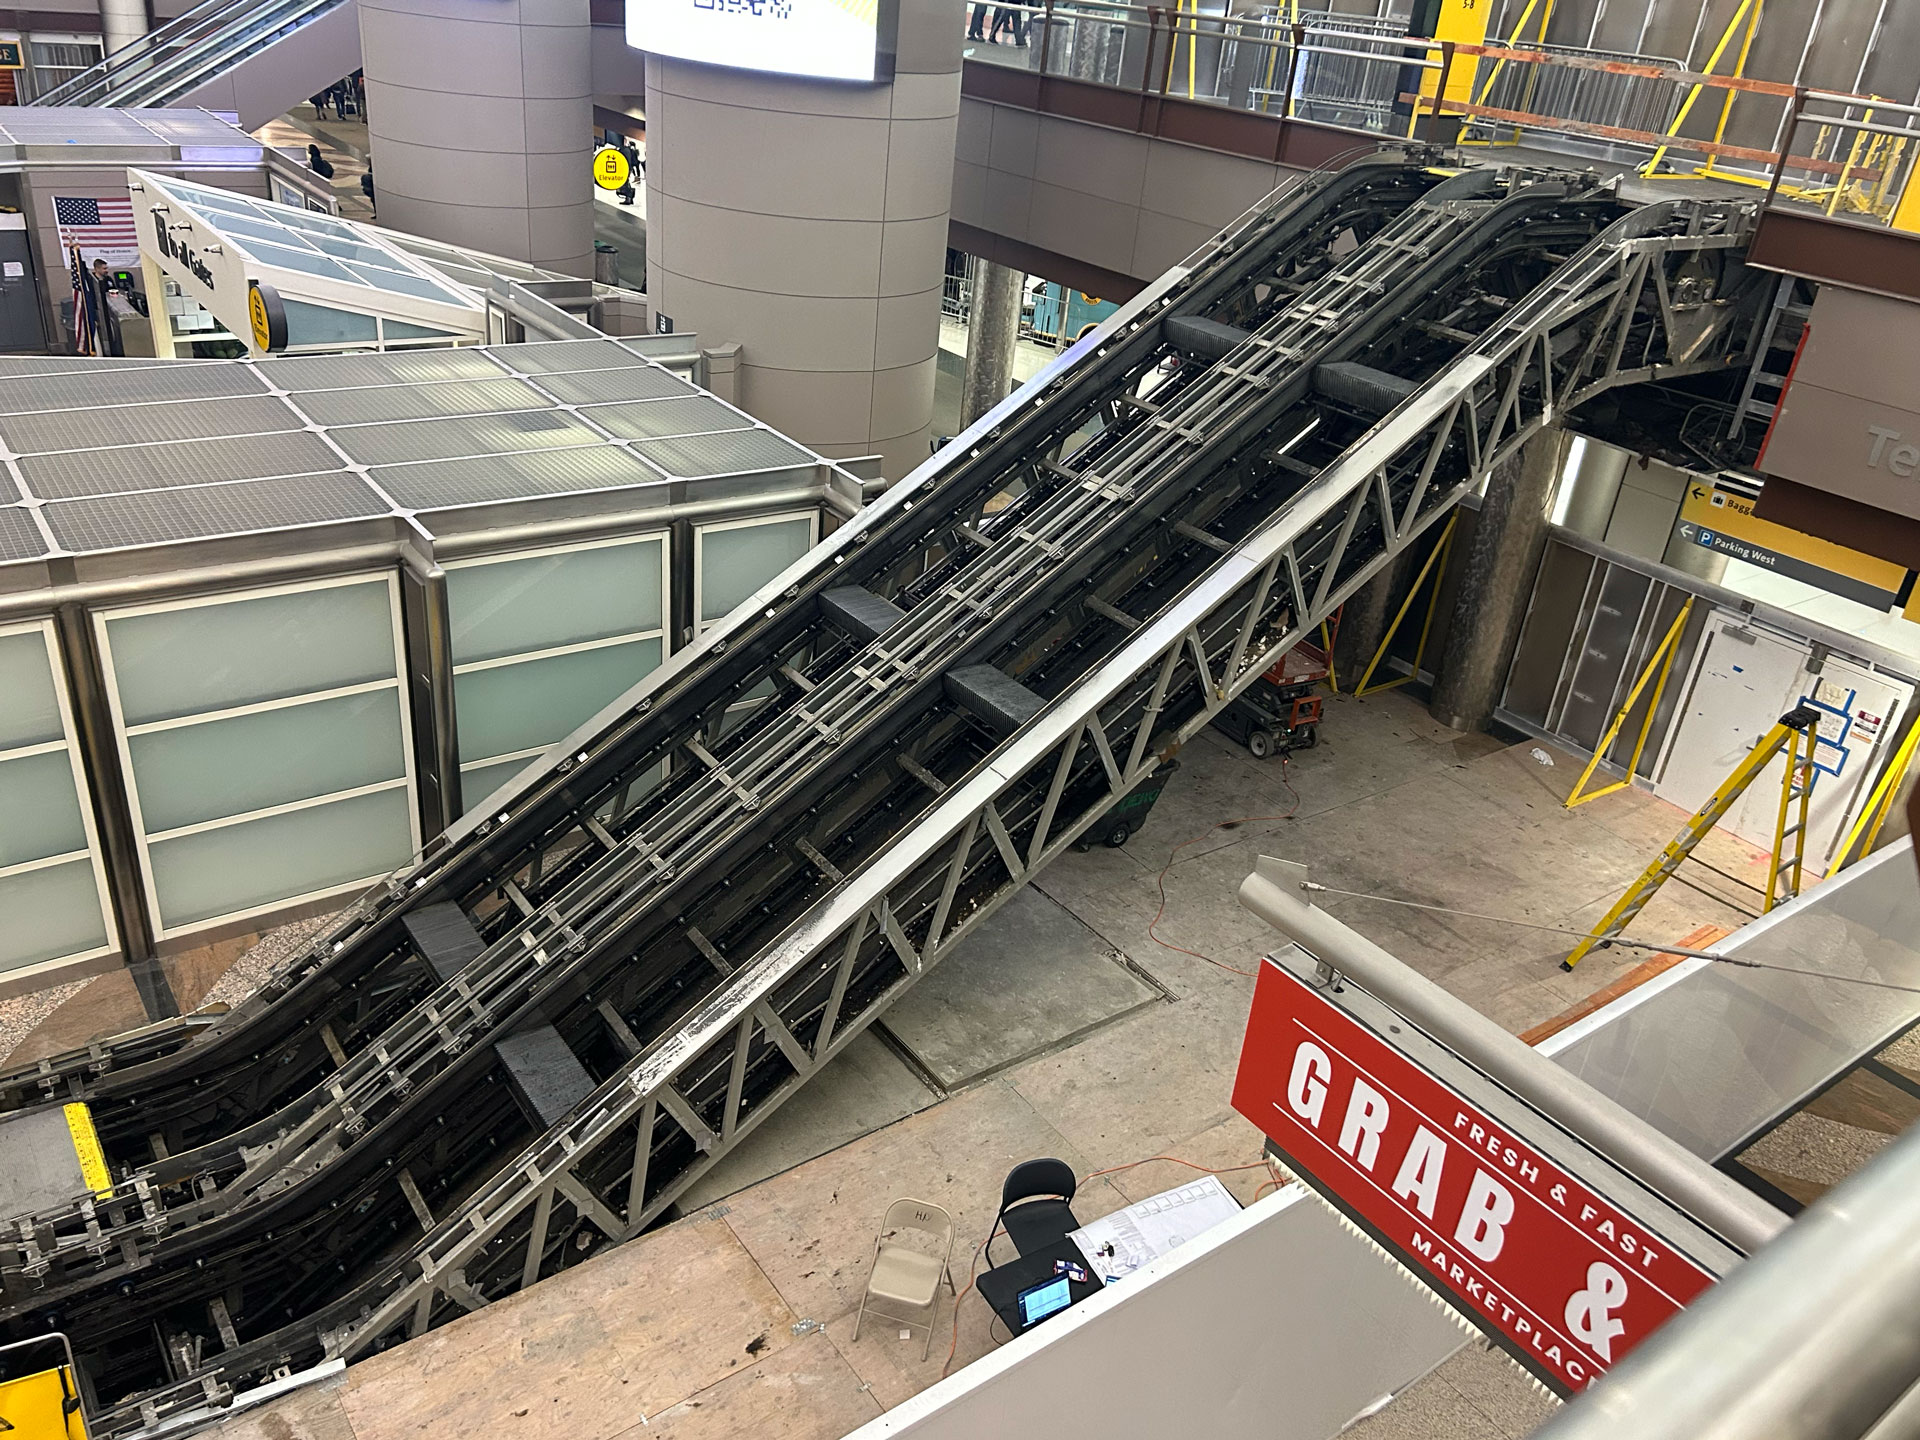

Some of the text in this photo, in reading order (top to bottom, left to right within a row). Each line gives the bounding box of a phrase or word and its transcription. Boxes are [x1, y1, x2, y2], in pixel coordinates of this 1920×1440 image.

[167, 232, 179, 259] to
[189, 249, 215, 291] Gates
[1867, 424, 1920, 482] Te
[1714, 537, 1750, 558] Parking
[1751, 550, 1776, 566] West
[1287, 1041, 1515, 1263] GRAB
[1564, 1261, 1630, 1364] &
[1454, 1112, 1659, 1267] FRESH & FAST
